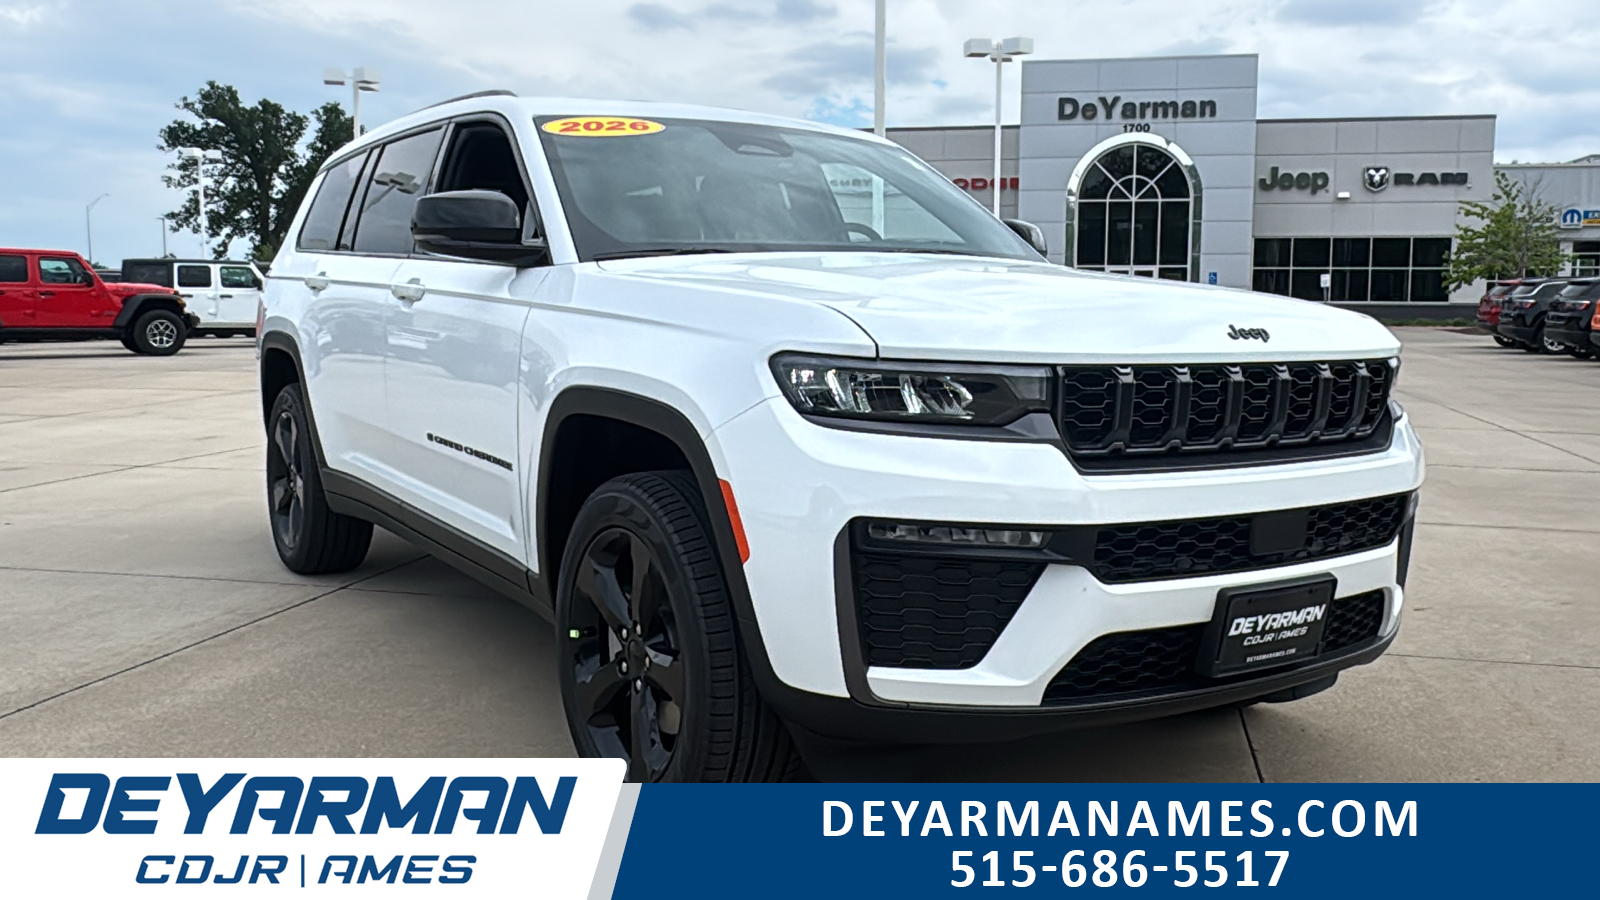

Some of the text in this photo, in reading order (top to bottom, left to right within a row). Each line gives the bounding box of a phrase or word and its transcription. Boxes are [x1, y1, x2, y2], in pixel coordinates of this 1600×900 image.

[1058, 96, 1217, 120] DeYarman
[559, 121, 650, 132] 2026
[1122, 123, 1151, 133] 1700
[1258, 166, 1329, 195] Jeep
[1394, 172, 1468, 186] RAM
[1227, 324, 1270, 343] Jeep
[1228, 604, 1327, 637] DEYARMAN
[1278, 626, 1309, 640] AMES
